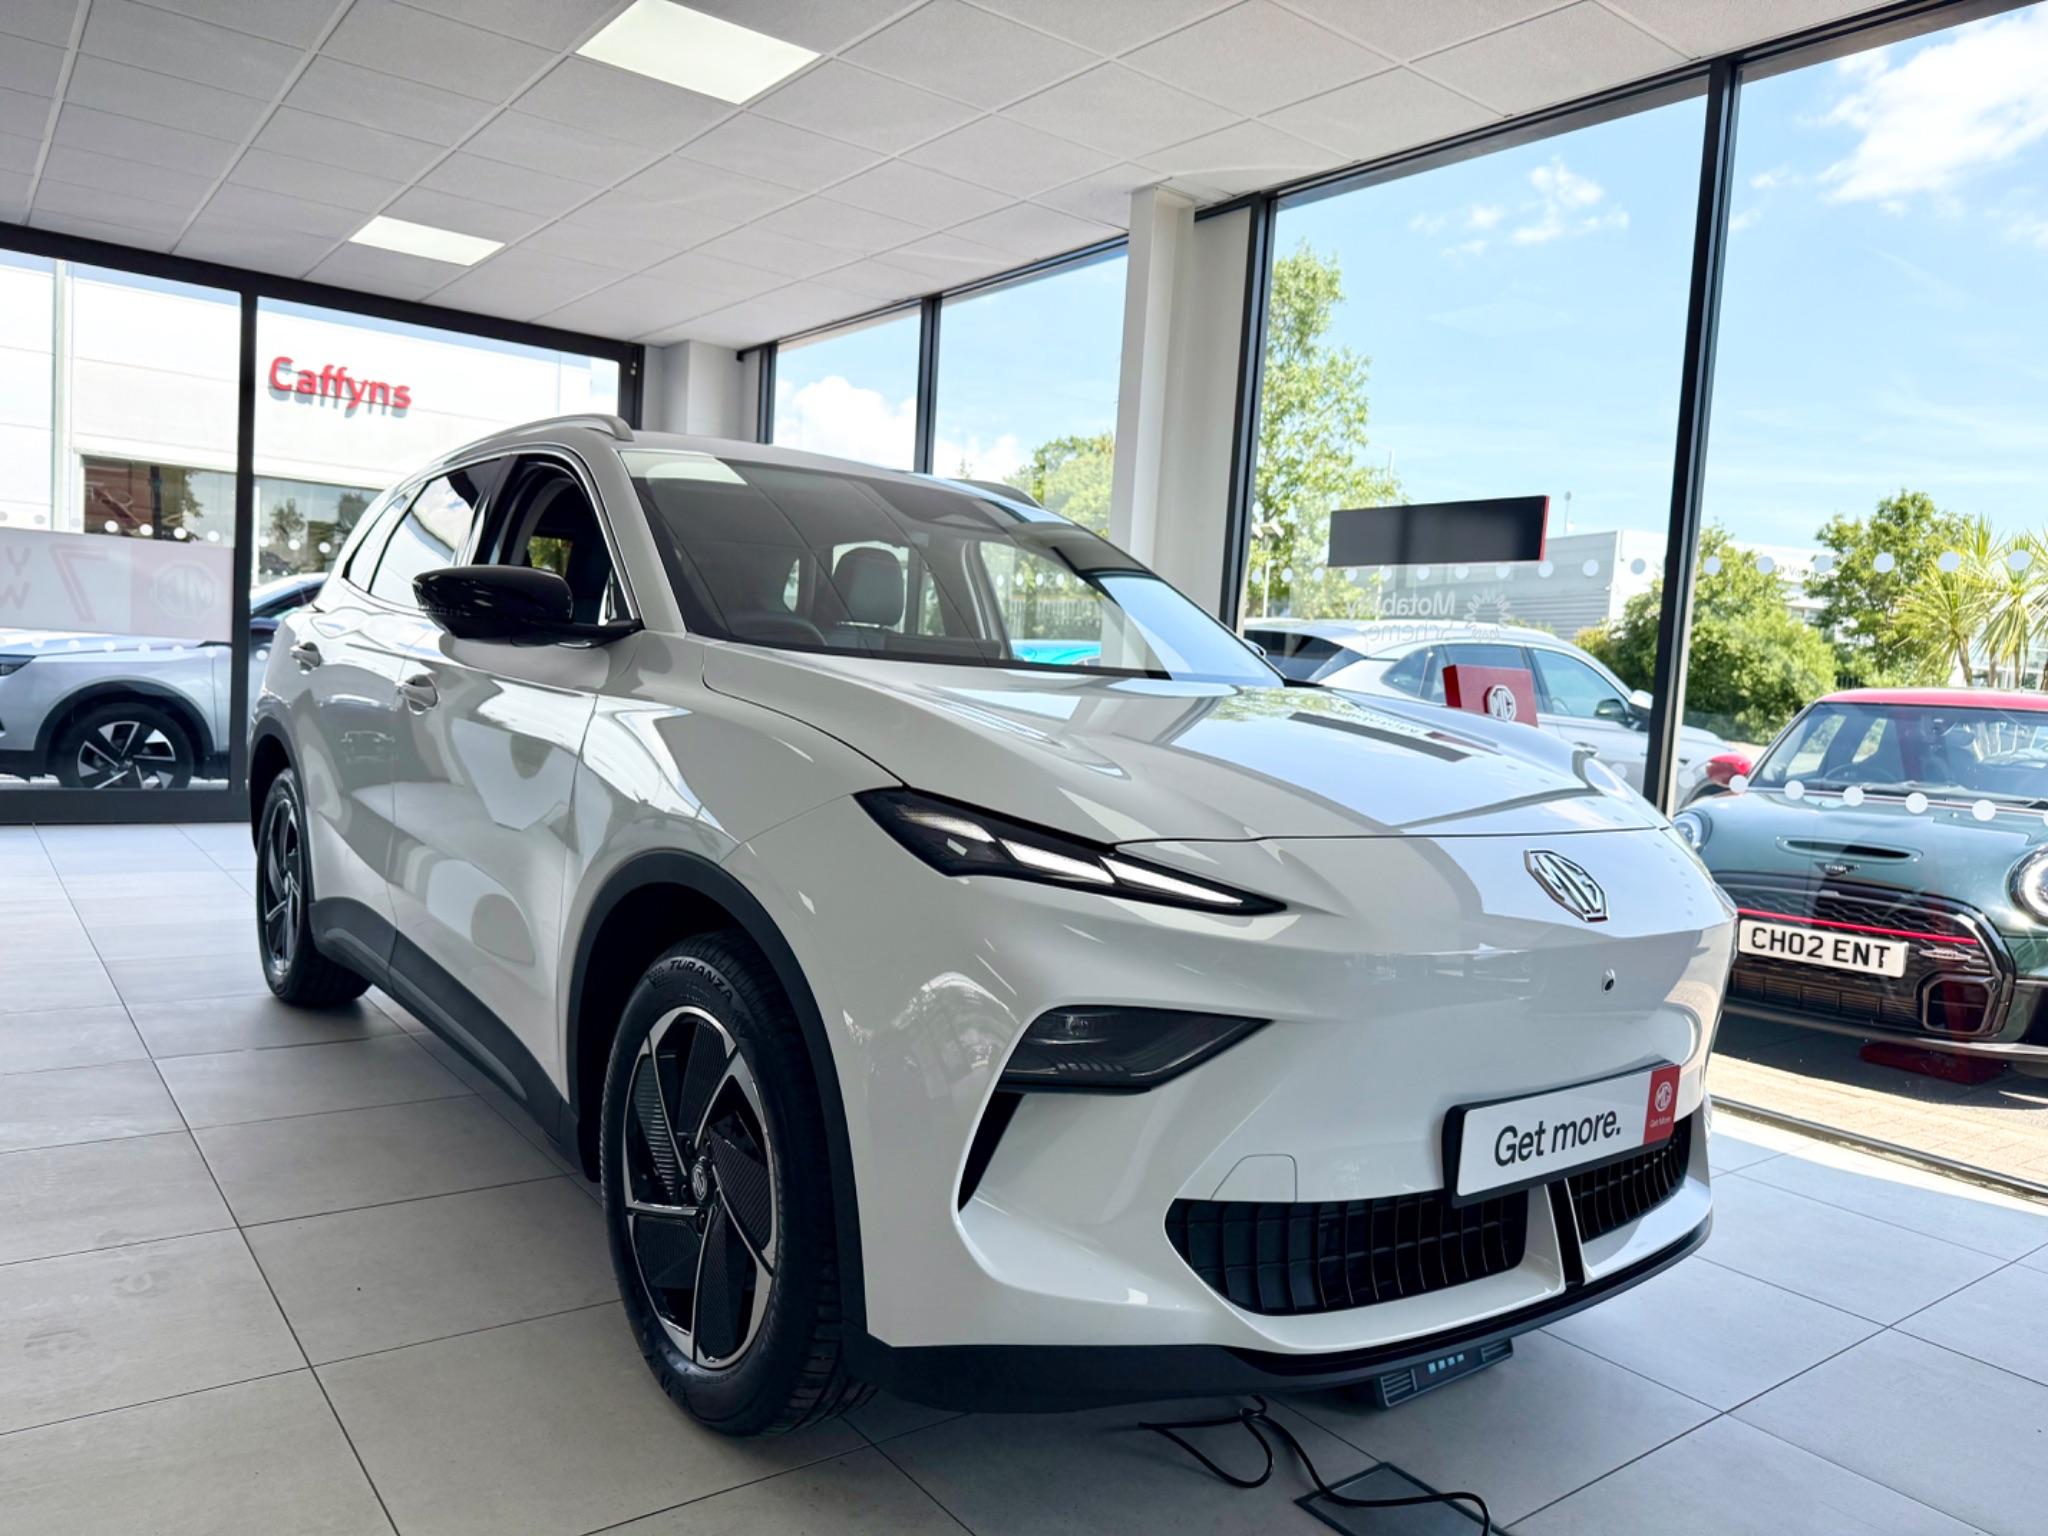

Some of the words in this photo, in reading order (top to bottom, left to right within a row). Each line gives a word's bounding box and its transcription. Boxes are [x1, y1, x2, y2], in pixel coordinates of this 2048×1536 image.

[269, 356, 411, 410] Caffyns
[1489, 687, 1516, 720] MG
[1529, 851, 1605, 917] MG
[1751, 926, 1824, 960] CH02
[1832, 939, 1891, 969] ENT
[670, 959, 733, 1003] TURANZA
[1494, 1120, 1546, 1167] Get
[1551, 1110, 1621, 1154] more.
